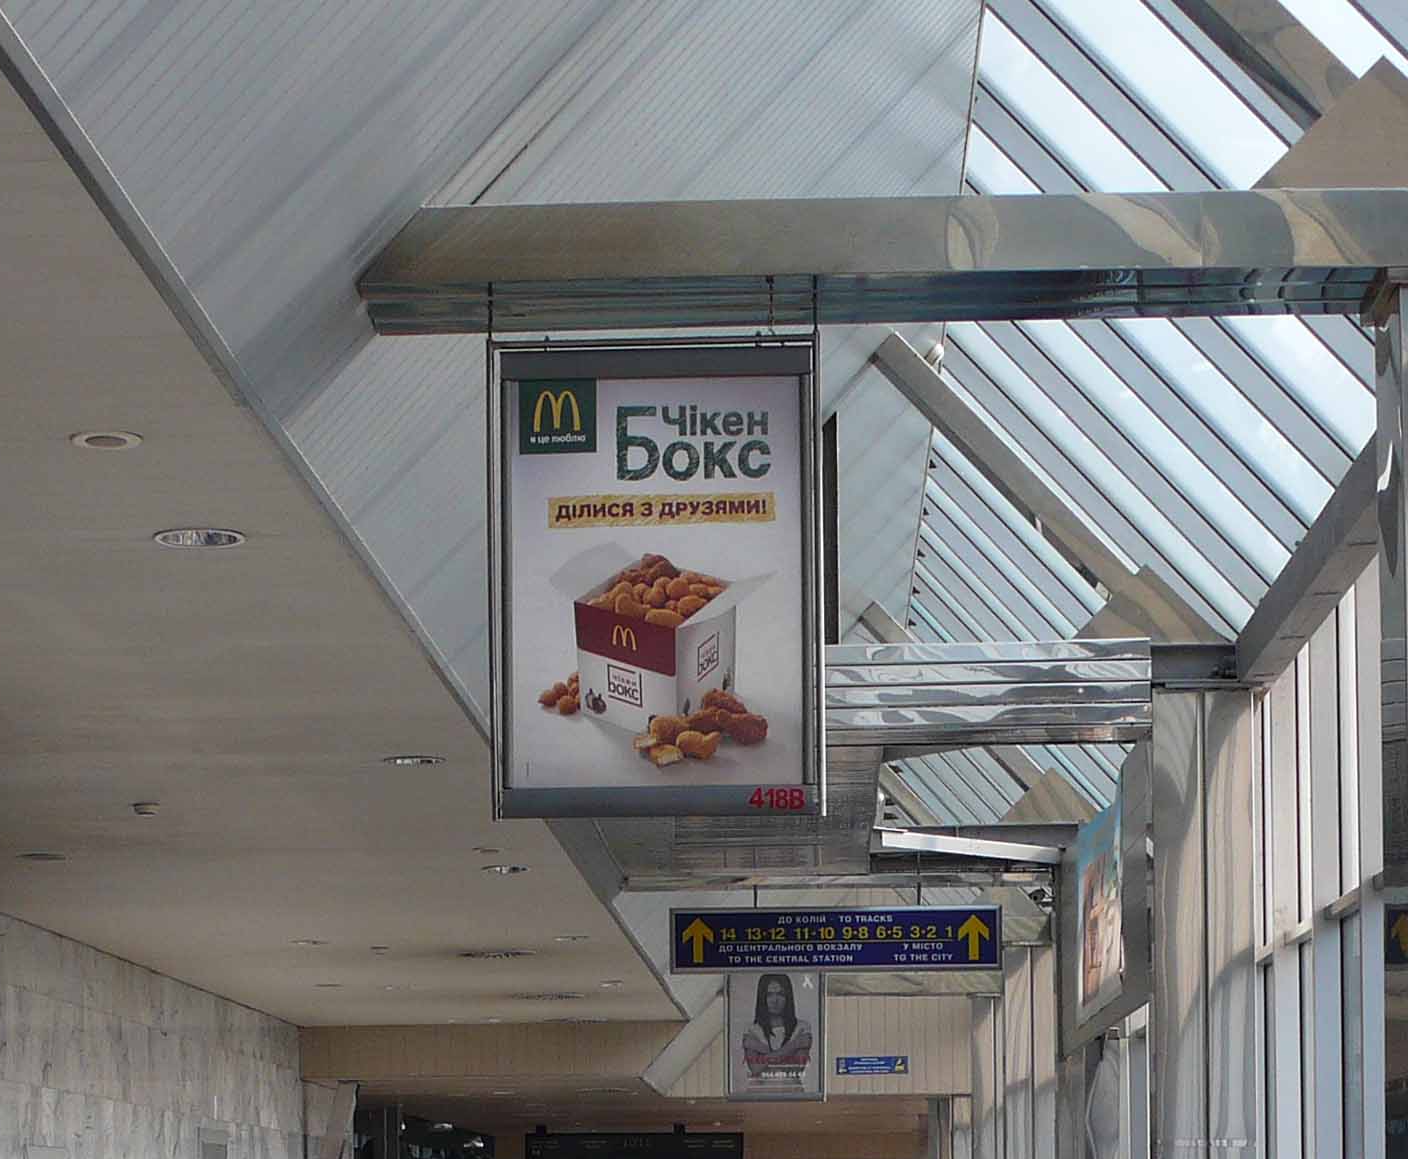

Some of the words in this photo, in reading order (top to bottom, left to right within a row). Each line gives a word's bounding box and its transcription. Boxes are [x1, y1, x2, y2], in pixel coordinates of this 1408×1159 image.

[661, 404, 769, 437] Чікен
[555, 502, 634, 522] ДІЛИСЯ
[640, 502, 653, 517] З
[659, 499, 767, 519] ДРУЗЯМИ!
[777, 916, 793, 925] ДО
[855, 914, 893, 922] TRACKS
[720, 928, 737, 939] 14
[945, 926, 953, 938] 1
[817, 943, 863, 951] ВОКЗАЛУ
[912, 942, 943, 950] МІСТО
[744, 955, 763, 963] THE
[766, 955, 809, 963] CENTRAL
[814, 954, 854, 963] STATION
[894, 953, 907, 962] TO
[910, 953, 928, 961] THE
[931, 953, 953, 961] CITY
